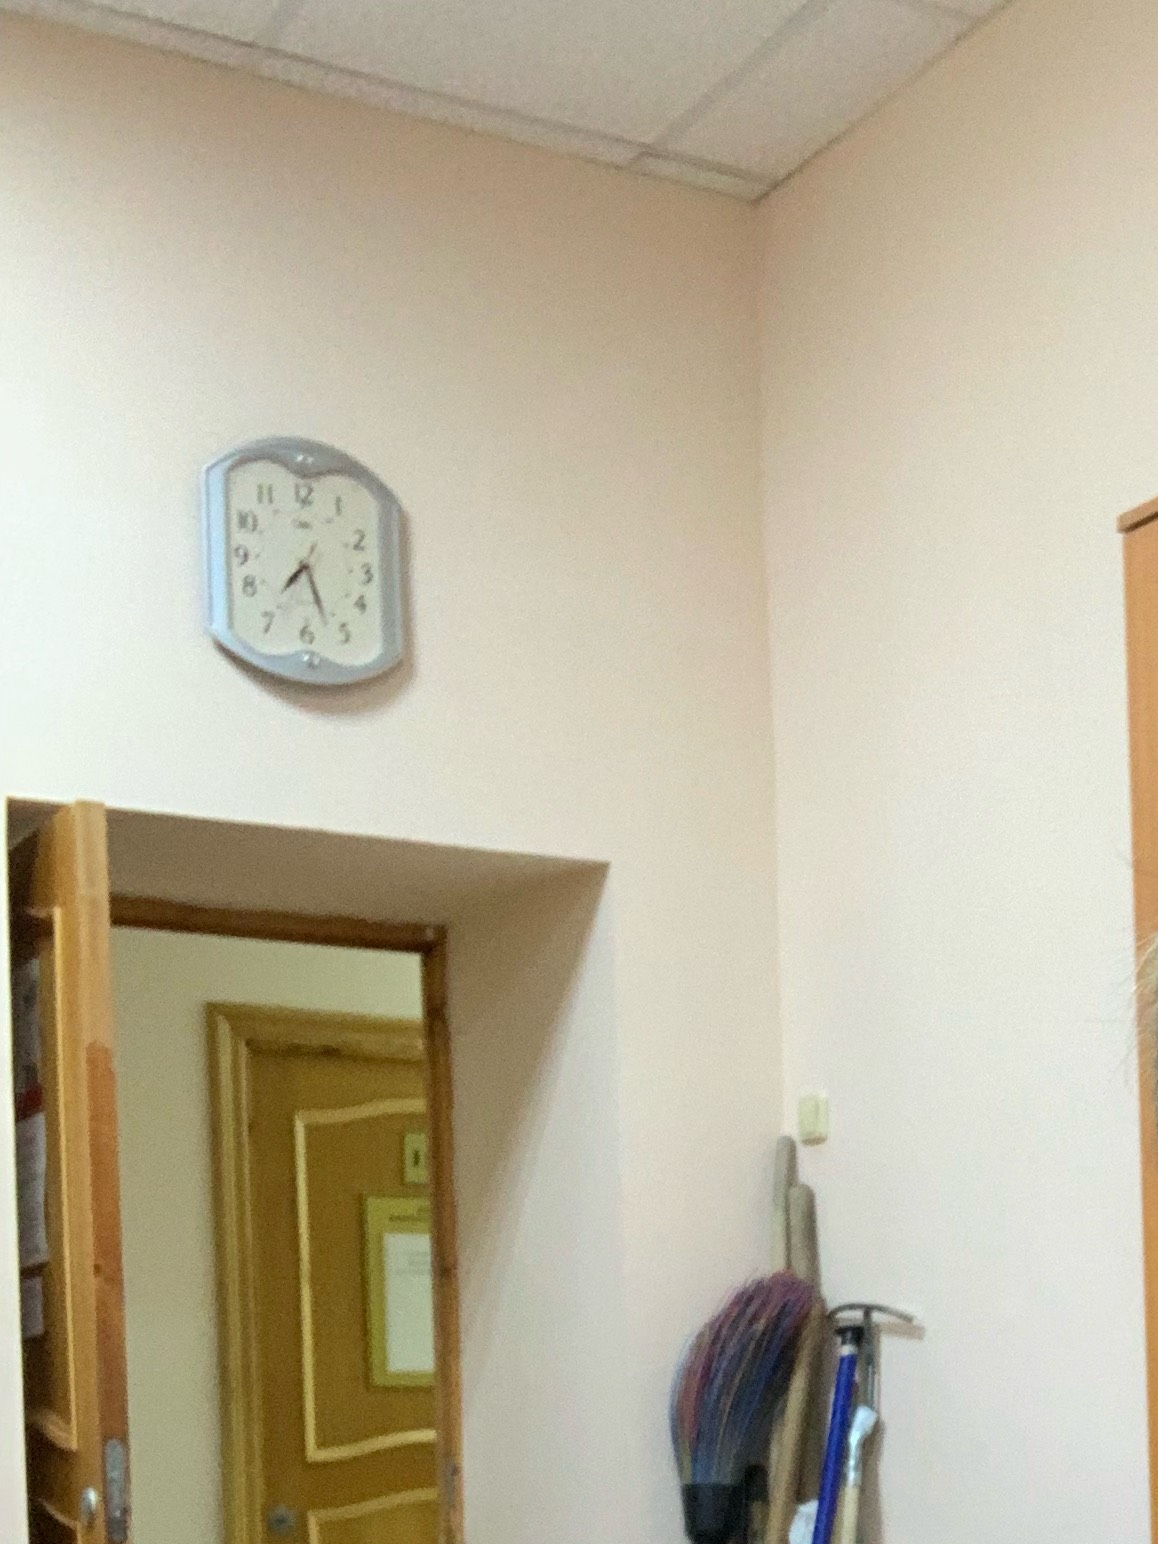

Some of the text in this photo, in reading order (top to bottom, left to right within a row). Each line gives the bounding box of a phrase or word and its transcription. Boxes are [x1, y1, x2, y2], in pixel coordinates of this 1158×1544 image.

[257, 484, 274, 504] 11
[294, 482, 314, 508] 12
[334, 495, 344, 516] 1
[353, 529, 367, 552] 2
[234, 545, 249, 567] 9
[242, 574, 258, 598] 8
[361, 563, 374, 586] 3
[354, 595, 368, 616] 4
[261, 610, 275, 634] 7
[338, 622, 352, 645] 5
[300, 624, 316, 645] 6
